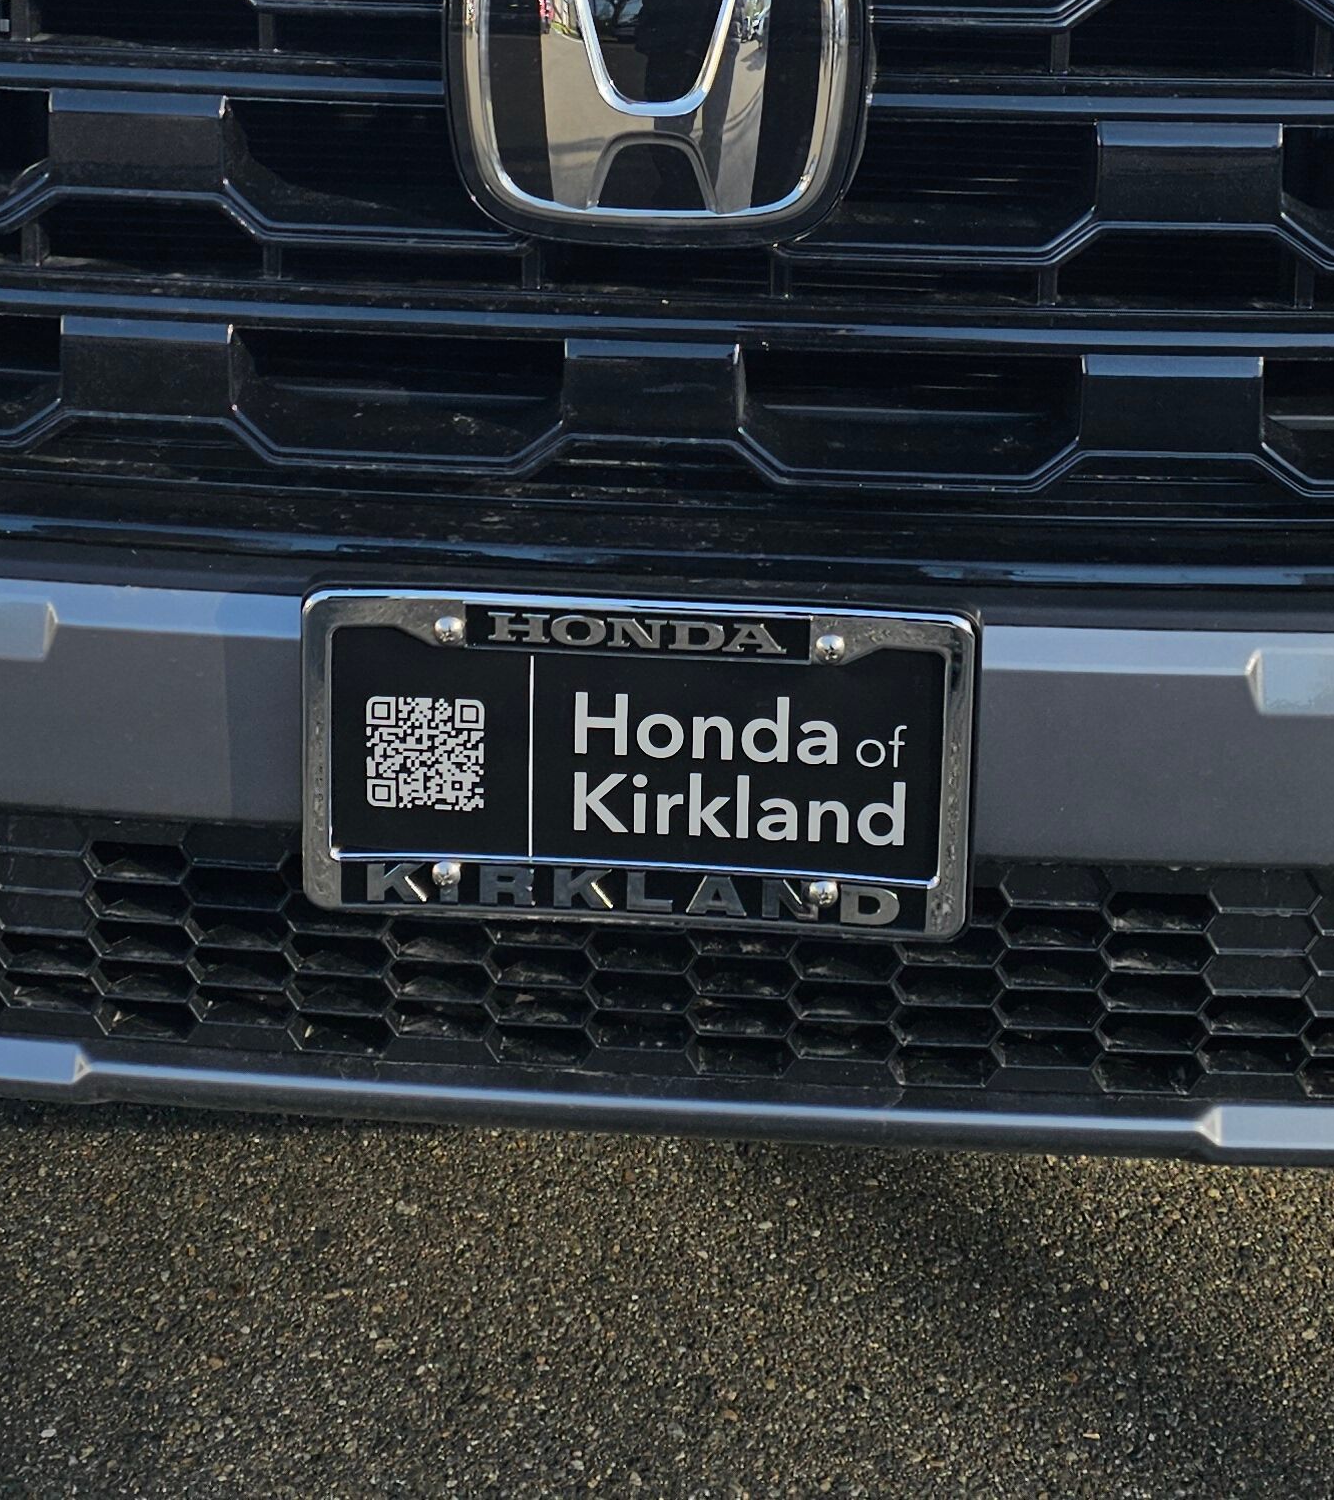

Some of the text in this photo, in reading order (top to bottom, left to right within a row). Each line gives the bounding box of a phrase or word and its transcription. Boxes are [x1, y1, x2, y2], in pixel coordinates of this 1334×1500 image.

[487, 611, 787, 654] HONDA
[573, 691, 907, 768] Honda of
[573, 772, 905, 846] Kirkland
